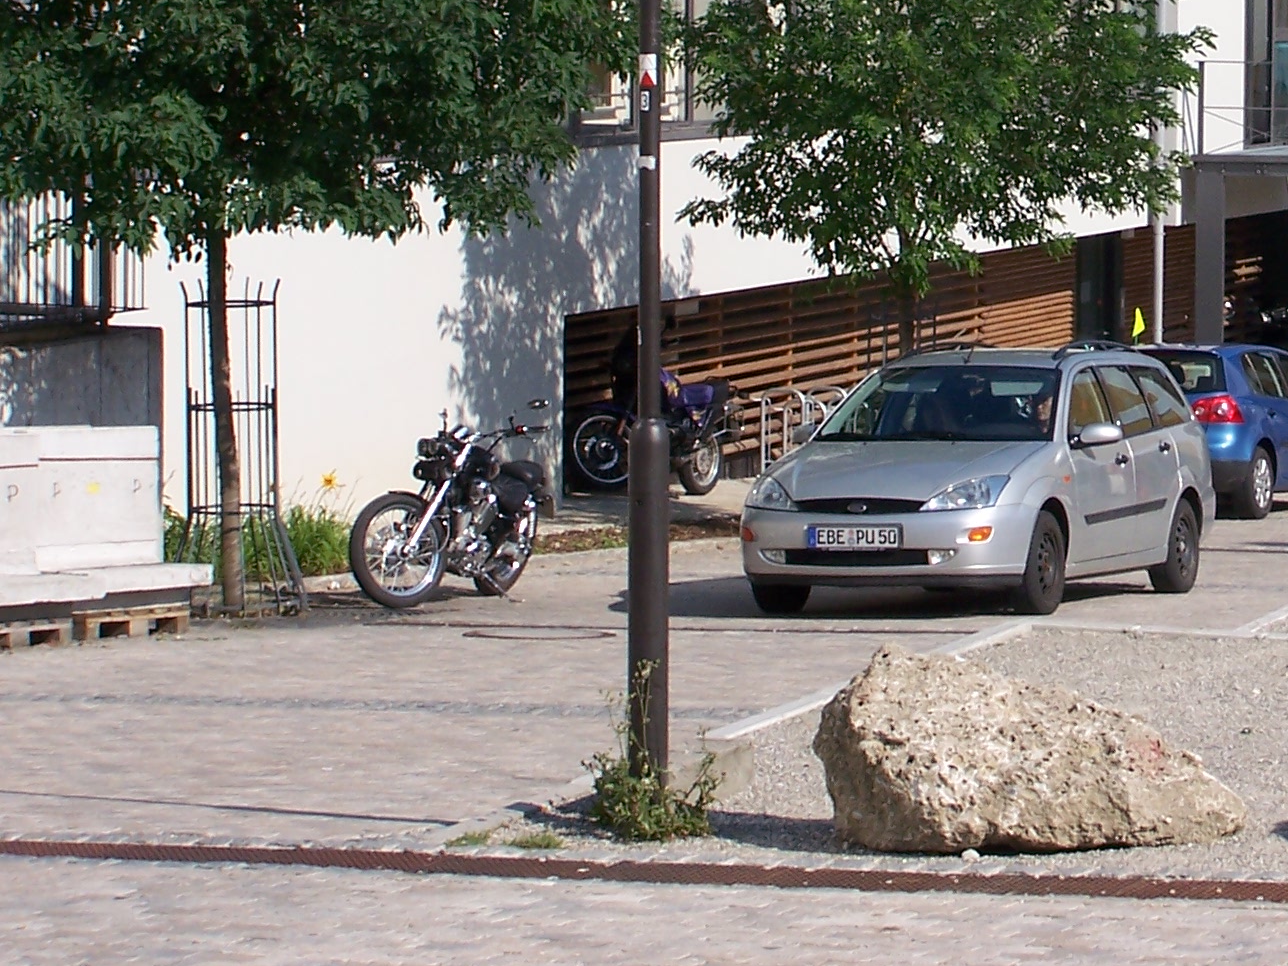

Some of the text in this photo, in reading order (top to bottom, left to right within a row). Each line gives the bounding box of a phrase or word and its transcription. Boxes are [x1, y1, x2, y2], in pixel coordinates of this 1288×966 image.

[817, 529, 897, 545] EBE PU 50
